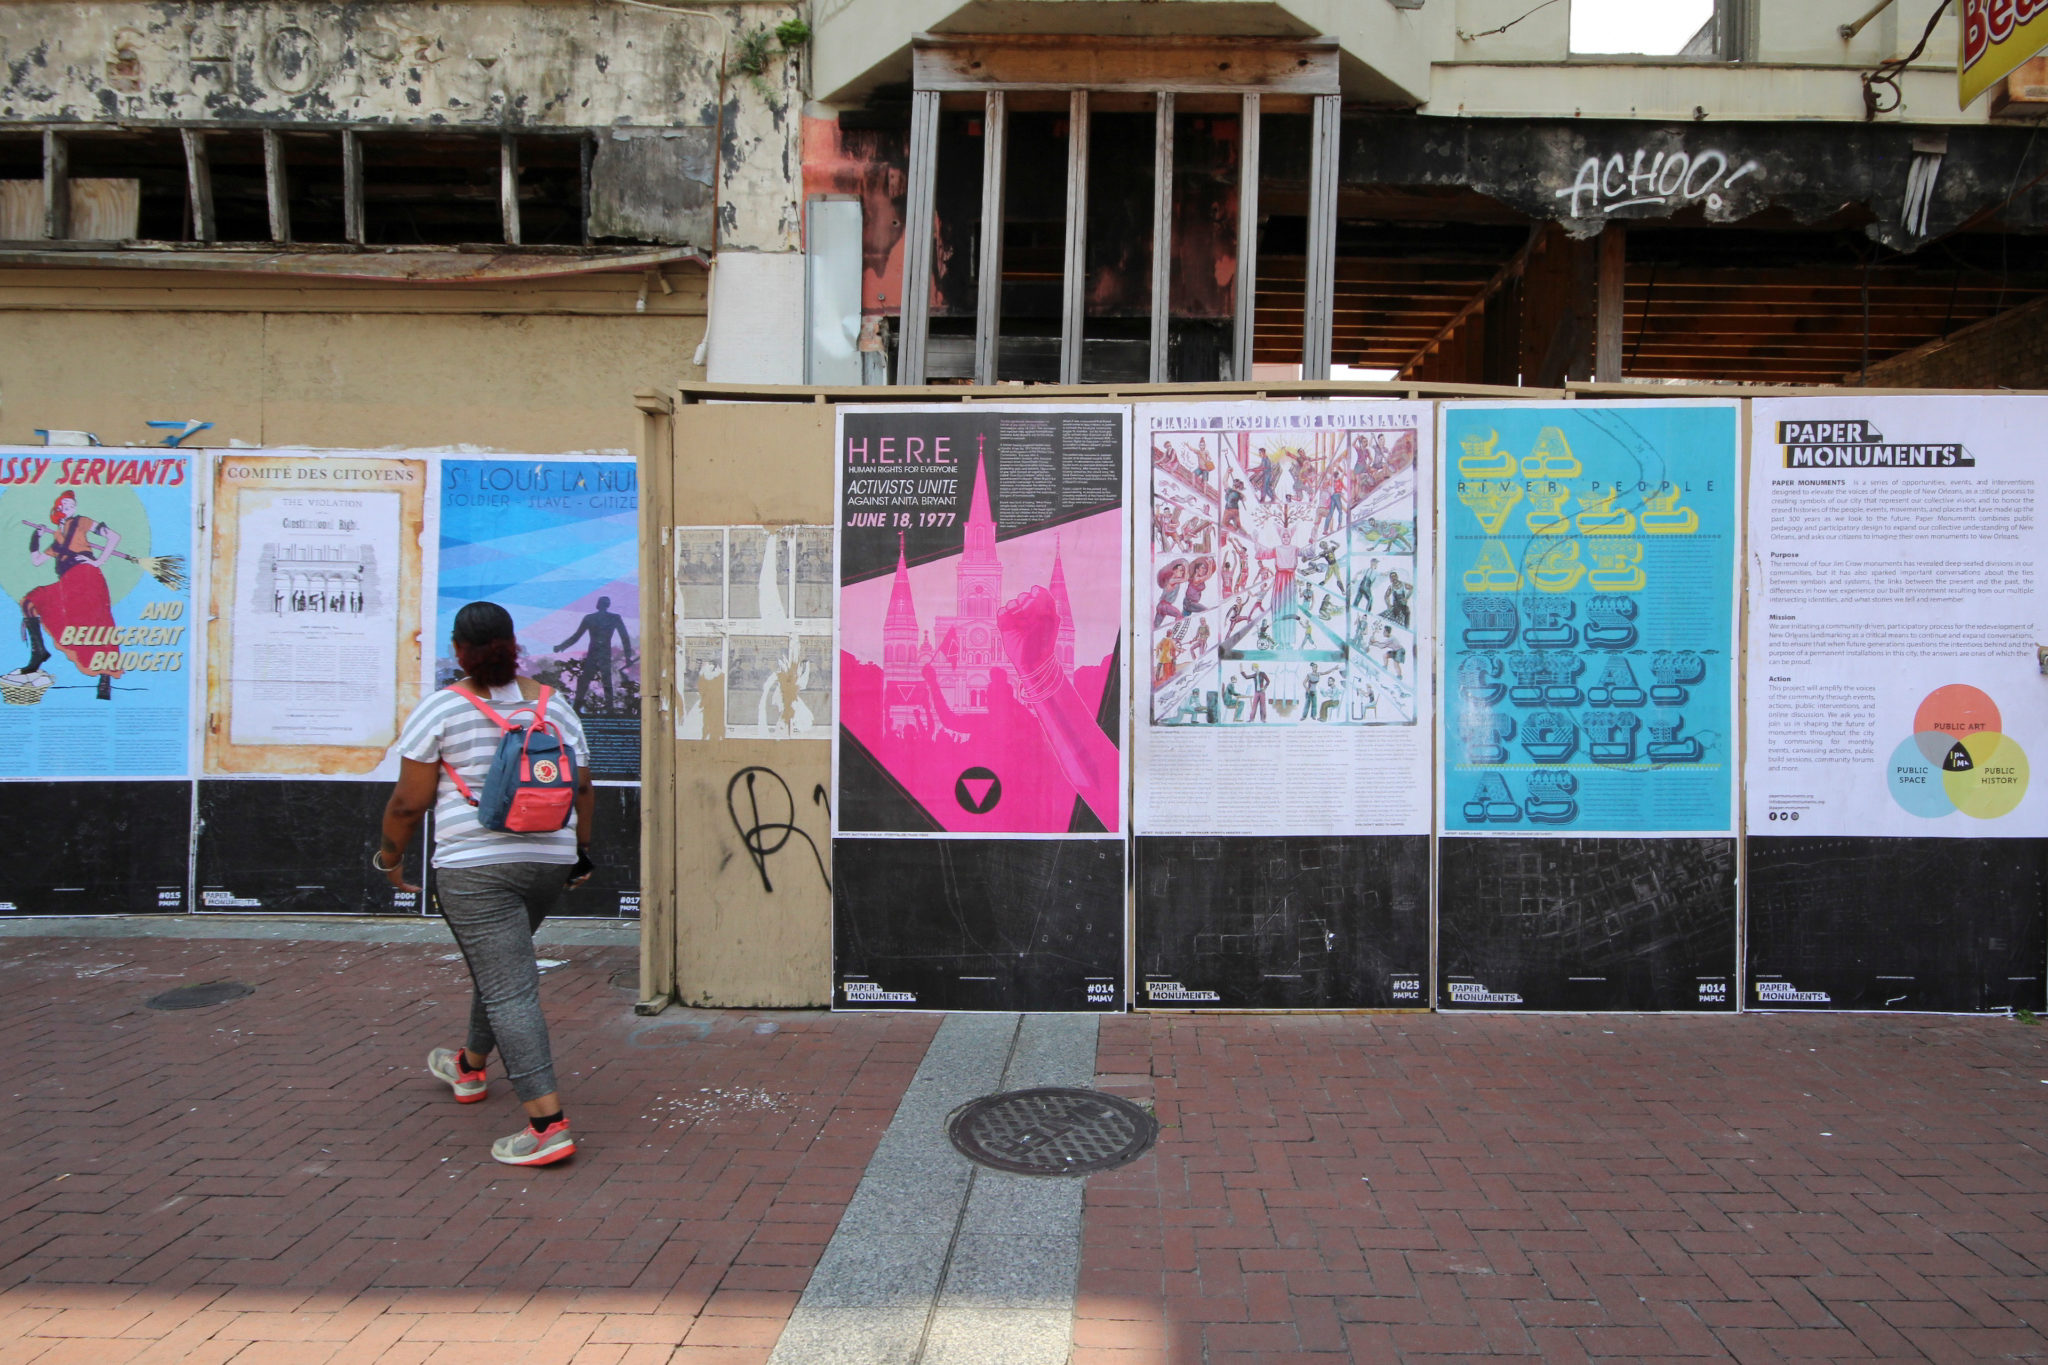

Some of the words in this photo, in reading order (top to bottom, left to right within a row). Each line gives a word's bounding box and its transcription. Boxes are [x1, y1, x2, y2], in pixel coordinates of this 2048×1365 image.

[1555, 148, 1758, 217] ACHOO!
[1151, 417, 1213, 429] CHARITY
[1226, 416, 1293, 429] HOSPITAL
[1323, 415, 1416, 428] LOUISIANA
[1785, 423, 1863, 443] PAPER
[849, 437, 958, 463] H.E.R.E.
[1792, 446, 1955, 466] MONUMENTS
[55, 458, 187, 486] SERVANTS
[228, 466, 292, 479] COMITÉ
[297, 468, 328, 479] DES
[333, 469, 414, 481] CITOYENS
[480, 467, 552, 491] LOUIS
[562, 471, 588, 492] LA
[848, 480, 914, 494] ACTIVISTS
[918, 480, 958, 494] UNITE
[1458, 482, 1556, 492] RIVER
[1592, 481, 1714, 492] PEOPLE
[1890, 488, 1912, 496] people
[282, 498, 303, 506] THE
[308, 499, 363, 508] VIOLATION
[448, 494, 509, 507] SOLDIER
[528, 495, 570, 508] SLAVE
[848, 497, 889, 505] AGAINST
[891, 497, 919, 505] ANITA
[922, 497, 957, 505] BRYANT
[847, 513, 887, 527] JUNE
[893, 513, 913, 529] 18,
[920, 513, 956, 527] 1977
[140, 601, 184, 621] AND
[60, 625, 185, 646] BELLIGERENT
[88, 651, 184, 671] BRIDGETS
[1815, 756, 1850, 764] community
[620, 896, 640, 904] #017
[1088, 984, 1114, 993] #014
[1393, 981, 1420, 990] #025
[1452, 984, 1480, 992] PAPER
[1699, 984, 1726, 992] #014
[850, 992, 908, 1000] MONUMENTS
[1153, 992, 1212, 1000] MONUMENTS
[1456, 993, 1516, 1001] MONUMENTS
[1762, 992, 1822, 1000] MONUMENTS
